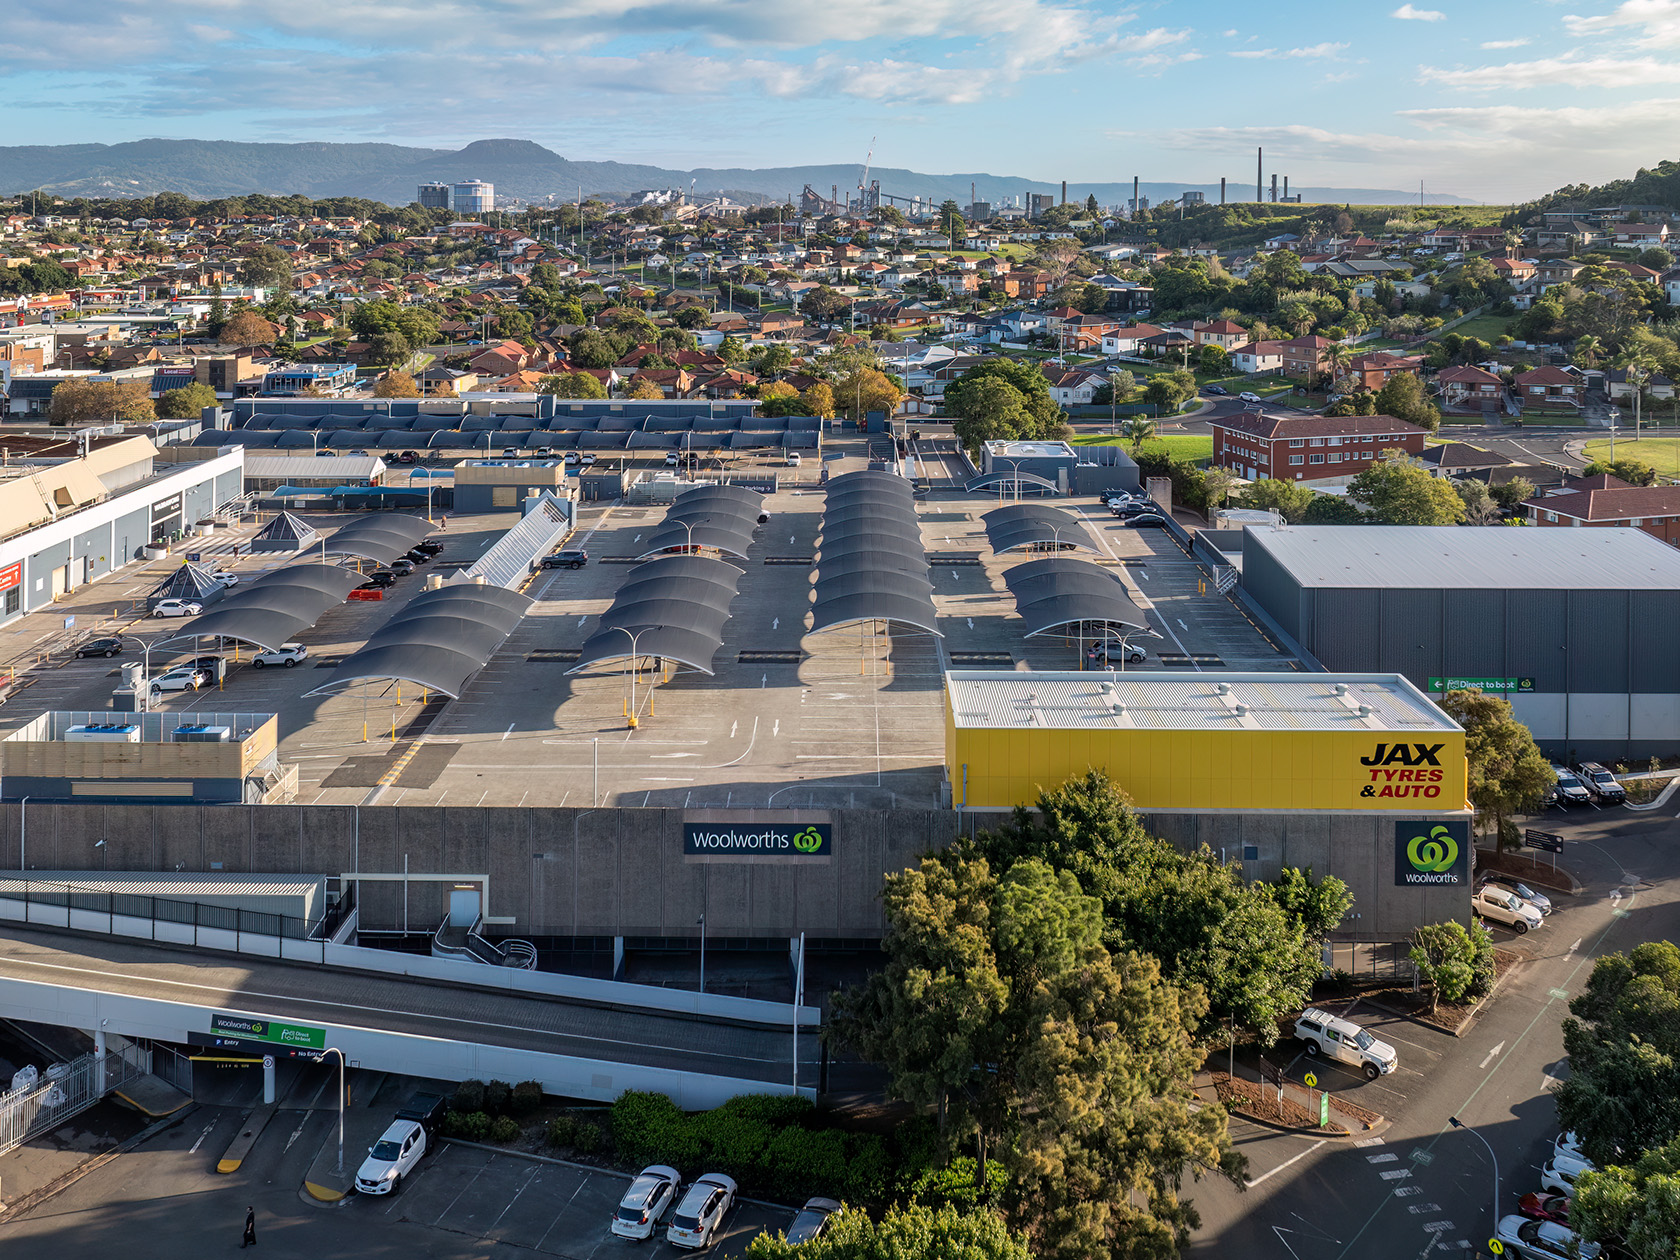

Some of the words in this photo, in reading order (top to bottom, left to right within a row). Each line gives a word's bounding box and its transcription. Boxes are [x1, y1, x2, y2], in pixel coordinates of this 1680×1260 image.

[1460, 680, 1484, 689] Direct
[1360, 743, 1446, 766] JAX
[1369, 769, 1444, 782] TYRES
[1360, 785, 1376, 798] &
[1378, 785, 1441, 798] AUTO
[692, 829, 790, 849] Woolworths
[1405, 872, 1459, 883] Woolworths
[217, 1019, 252, 1031] Woolworths
